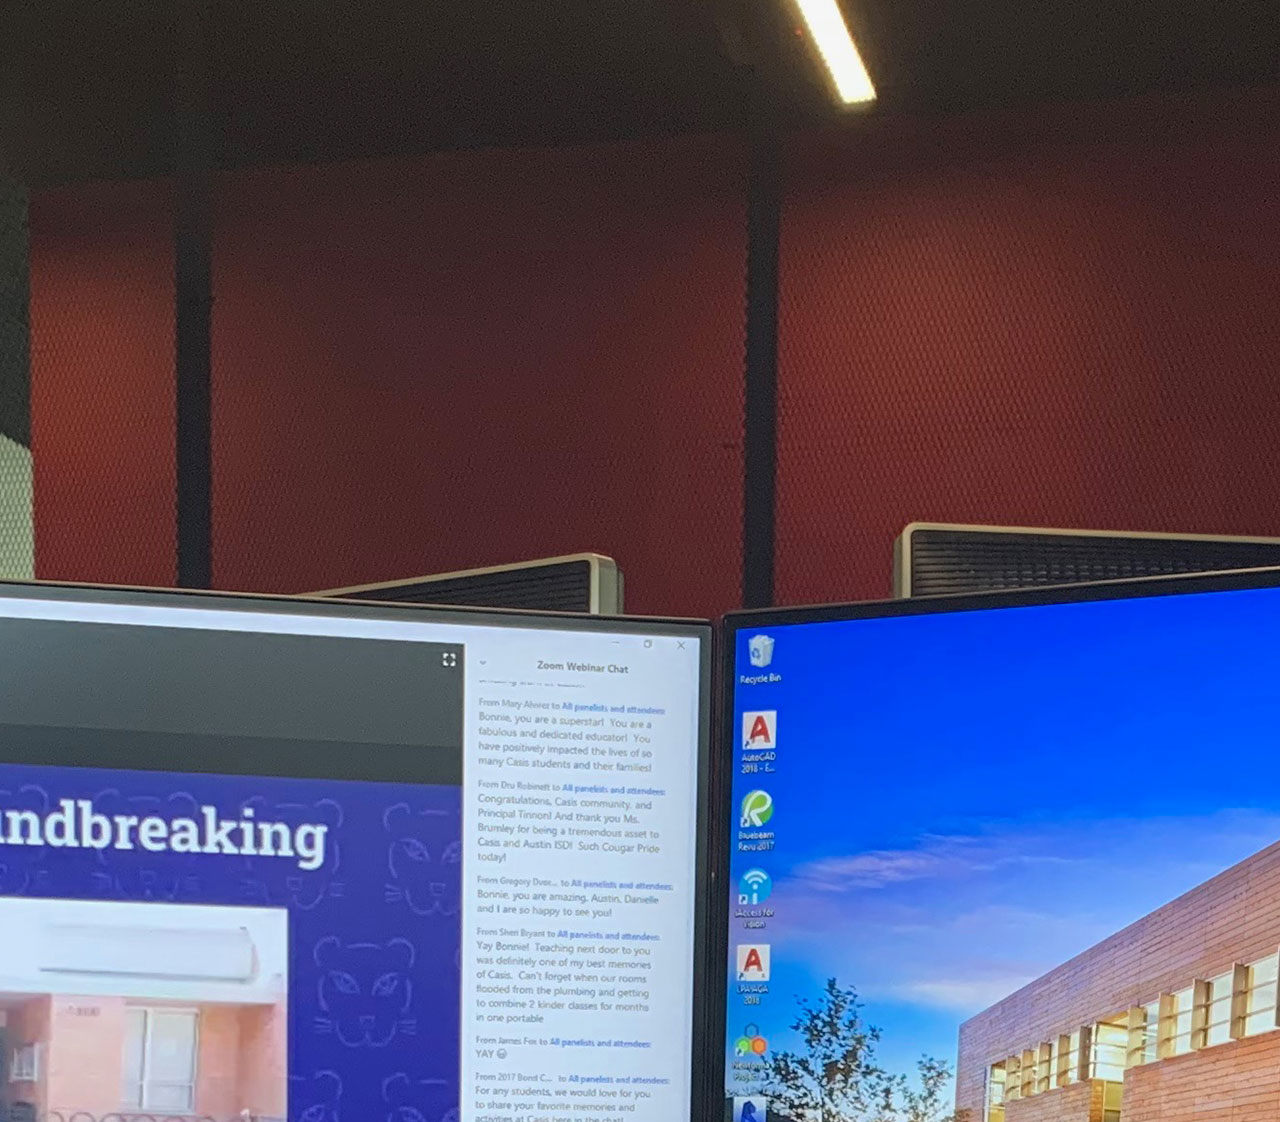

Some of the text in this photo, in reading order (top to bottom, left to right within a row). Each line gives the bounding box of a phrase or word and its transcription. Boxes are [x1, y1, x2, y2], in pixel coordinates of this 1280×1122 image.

[537, 660, 628, 673] Zoom Webinar Chat
[740, 673, 781, 685] Recycle Bin
[515, 715, 531, 724] you
[610, 718, 627, 727] You
[478, 809, 515, 821] Principal
[555, 812, 572, 821] And
[576, 813, 601, 822] thank
[604, 816, 621, 824] you
[478, 904, 494, 913] and
[533, 906, 560, 916] happy
[476, 1049, 493, 1058] YAY
[475, 1086, 489, 1094] For
[493, 1088, 508, 1097] any
[570, 1088, 596, 1096] would
[599, 1089, 616, 1097] love
[620, 1089, 632, 1097] for
[634, 1091, 651, 1099] you
